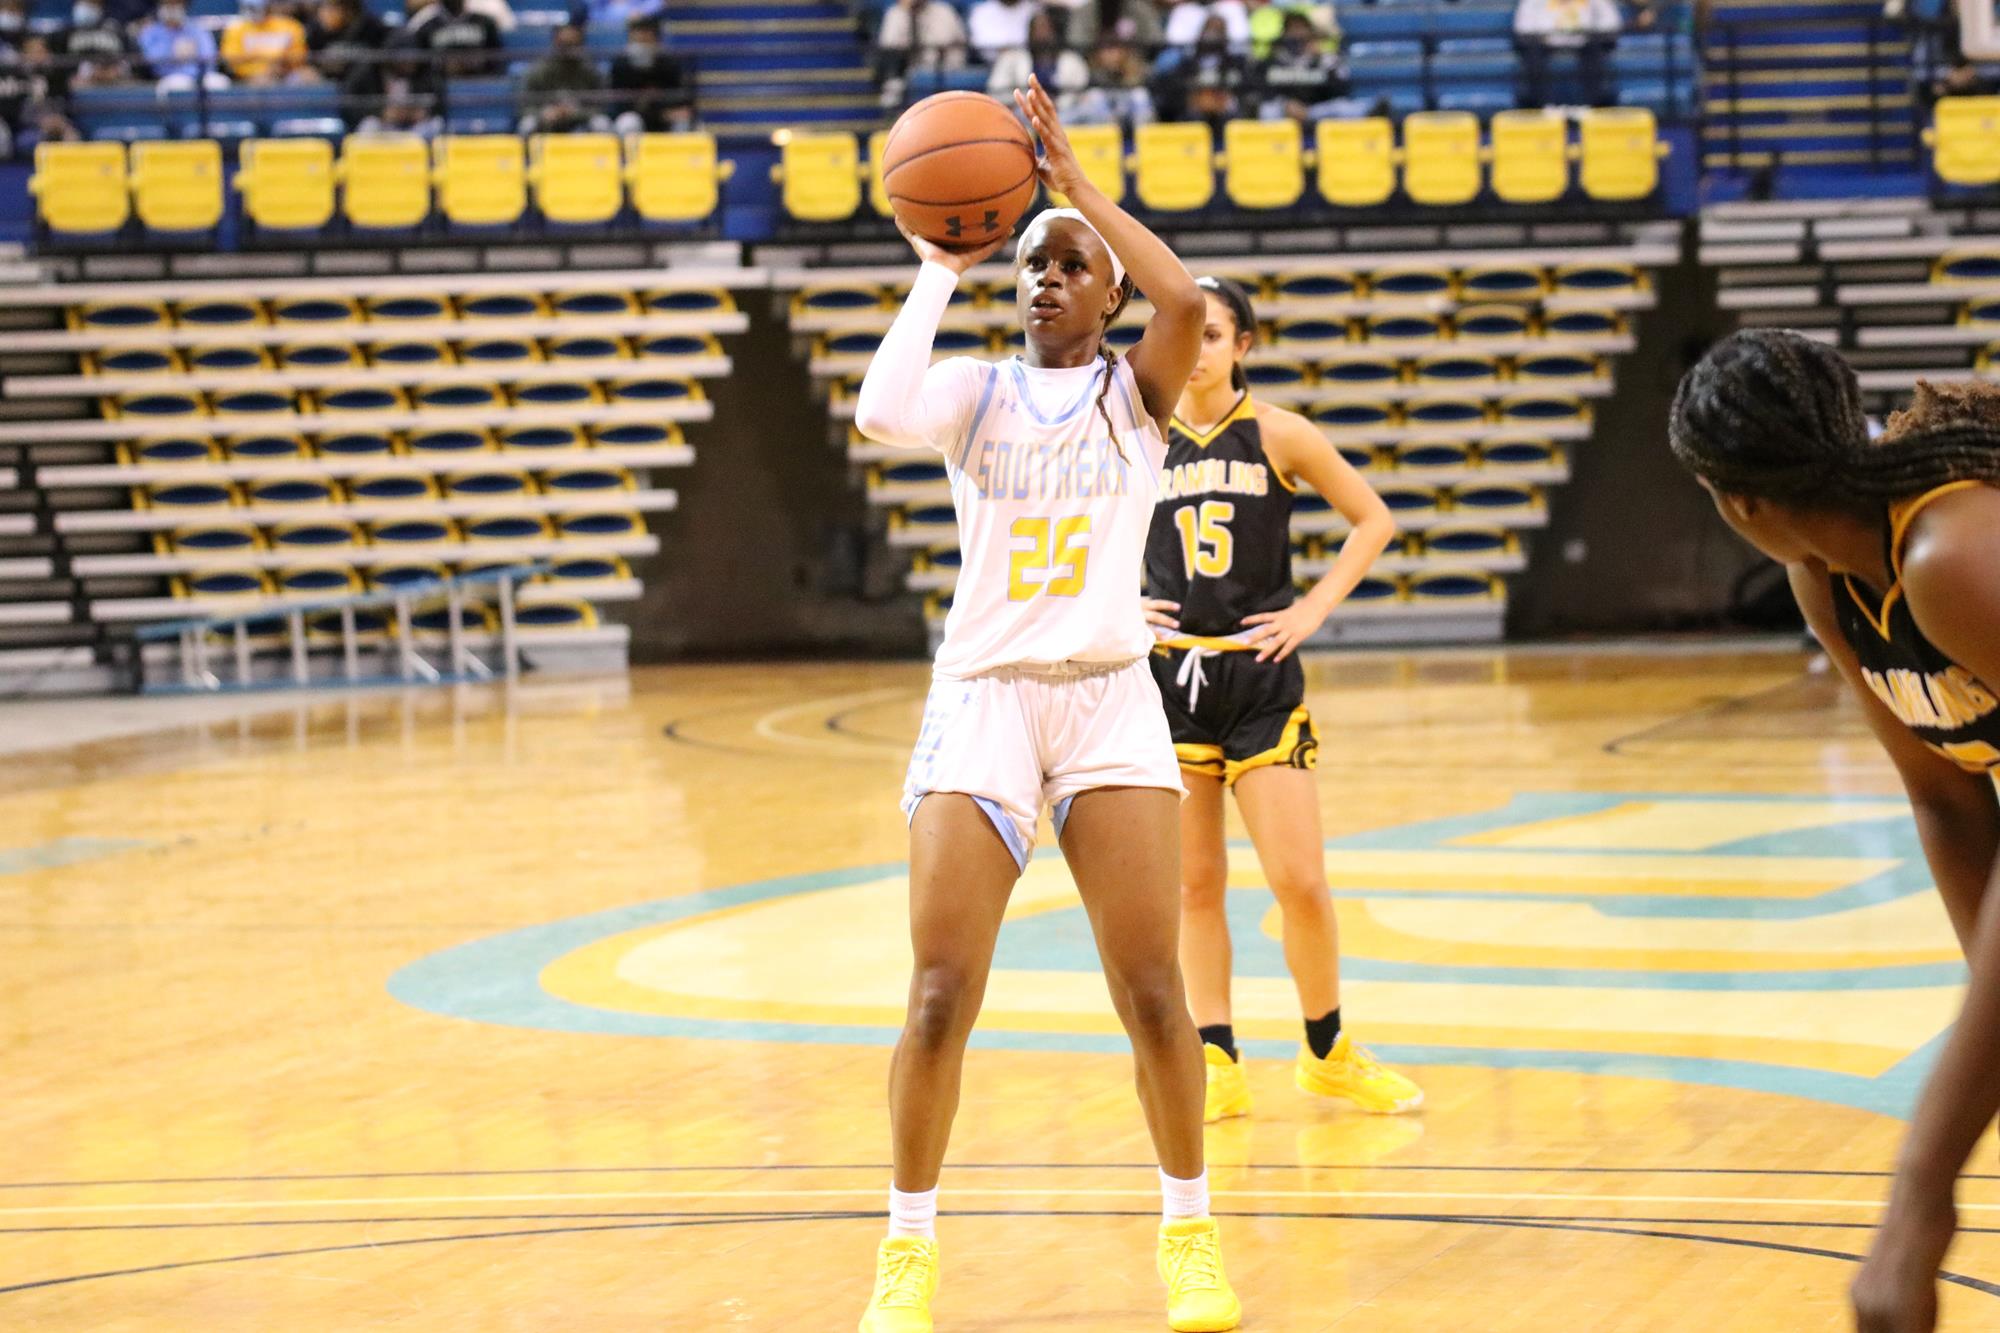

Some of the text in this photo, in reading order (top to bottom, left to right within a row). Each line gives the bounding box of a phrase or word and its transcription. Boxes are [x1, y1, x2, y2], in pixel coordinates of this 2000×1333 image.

[977, 436, 1128, 500] SOUTHERN
[1007, 514, 1092, 602] 25
[1174, 500, 1234, 580] 15
